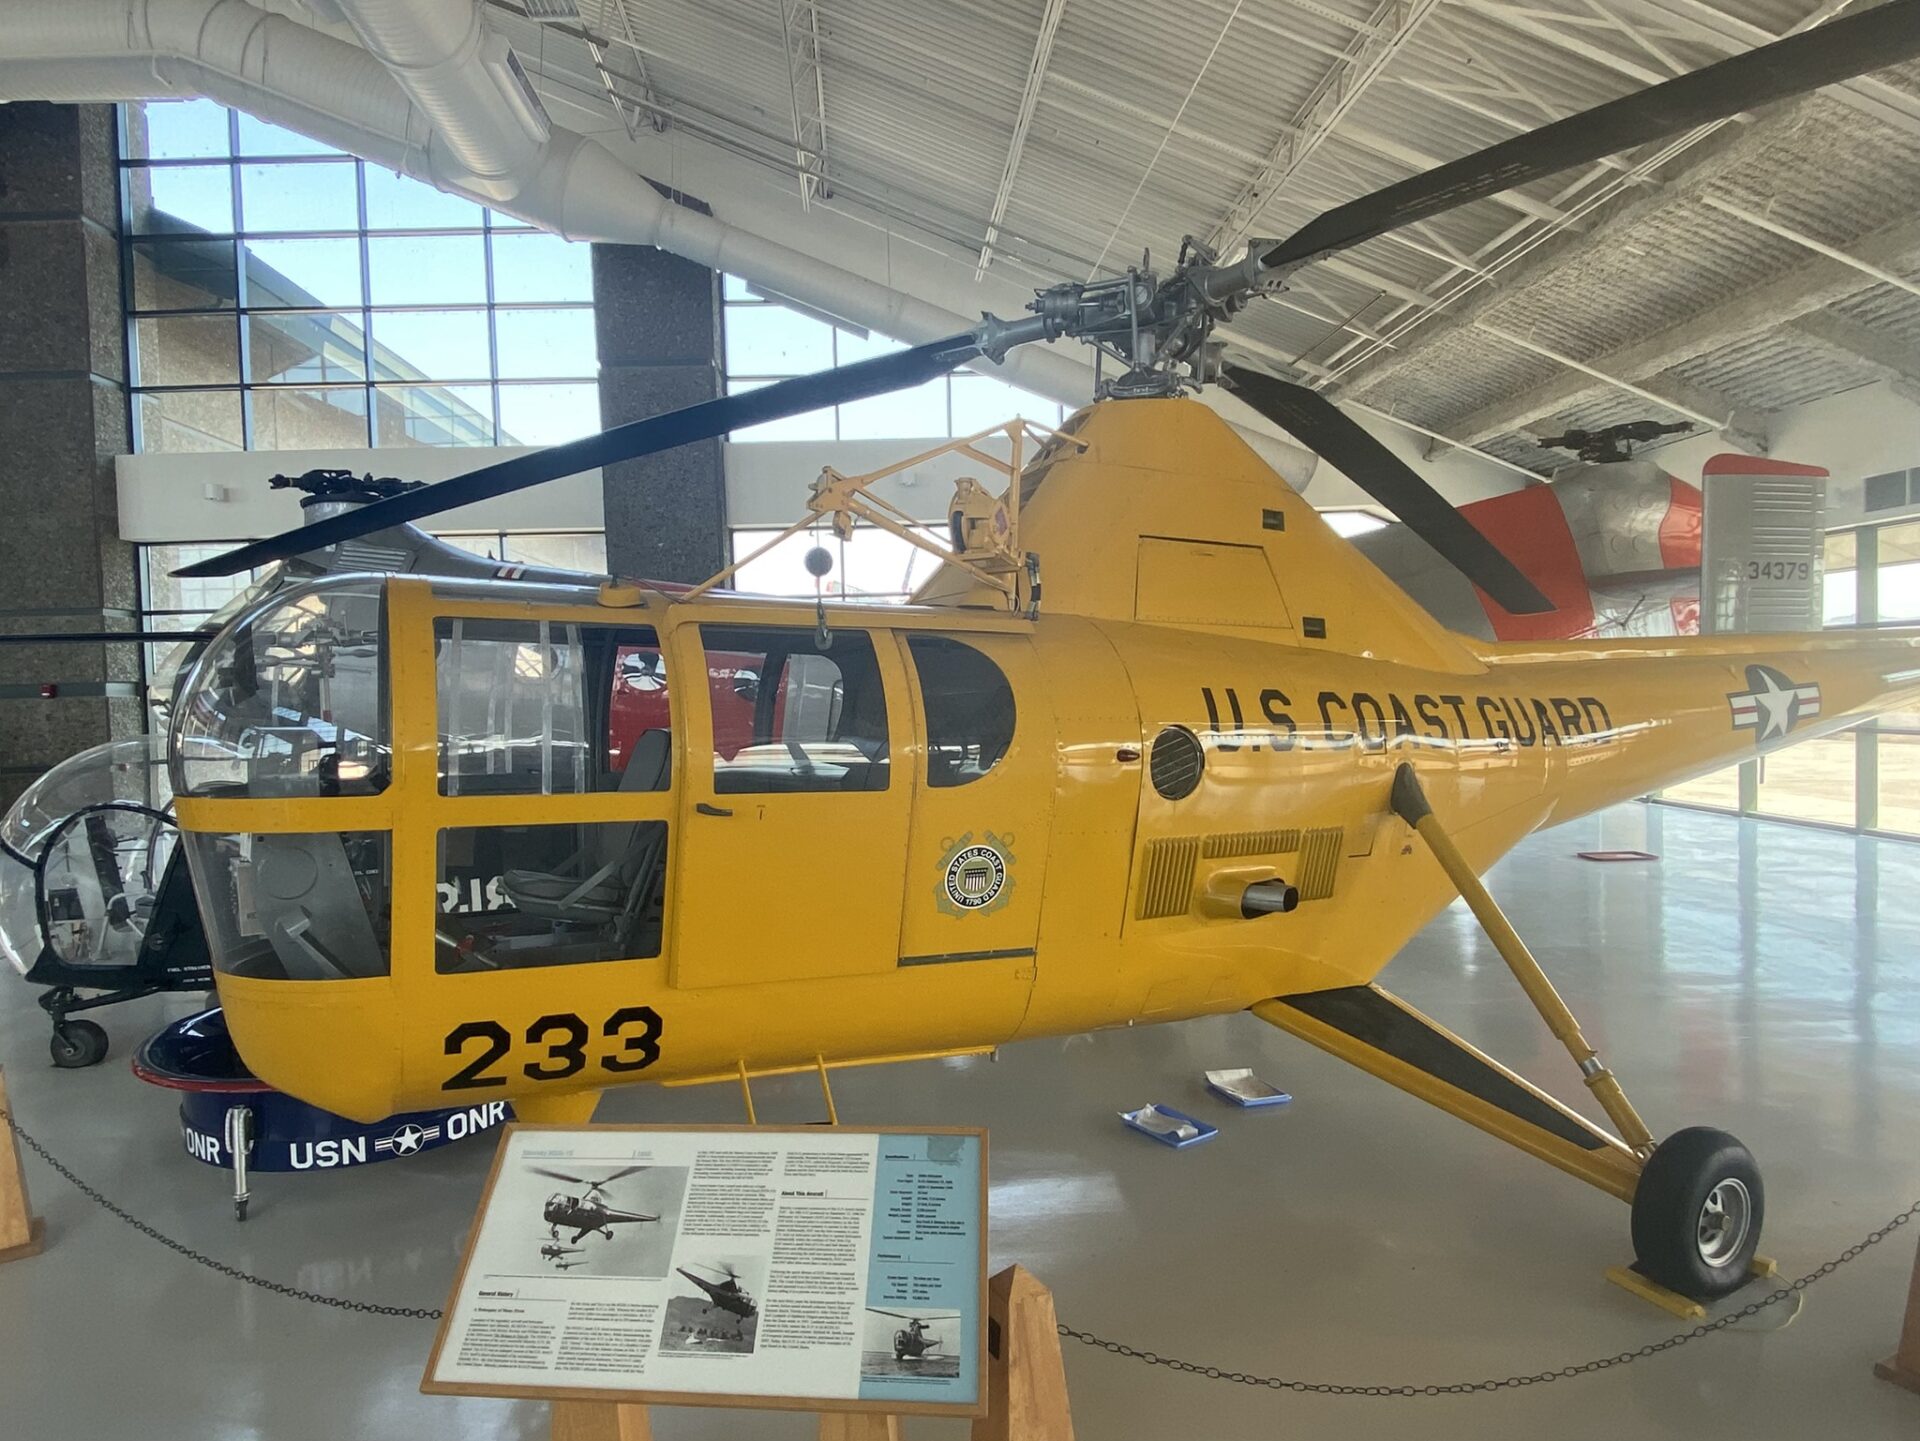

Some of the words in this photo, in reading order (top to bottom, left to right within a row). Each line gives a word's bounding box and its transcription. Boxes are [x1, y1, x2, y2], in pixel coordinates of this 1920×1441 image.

[1748, 561, 1809, 580] 34379
[1202, 687, 1312, 751] U.S.
[1317, 691, 1471, 750] COAST
[1476, 696, 1613, 748] GUARD
[951, 848, 979, 873] STATES
[980, 849, 1002, 870] COAST
[948, 874, 965, 903] UNITED
[982, 872, 1003, 901] GUARD
[965, 898, 982, 906] 1790
[441, 1006, 663, 1091] 233
[447, 1100, 505, 1140] ONR
[187, 1127, 220, 1165] ONR
[290, 1136, 367, 1169] USN
